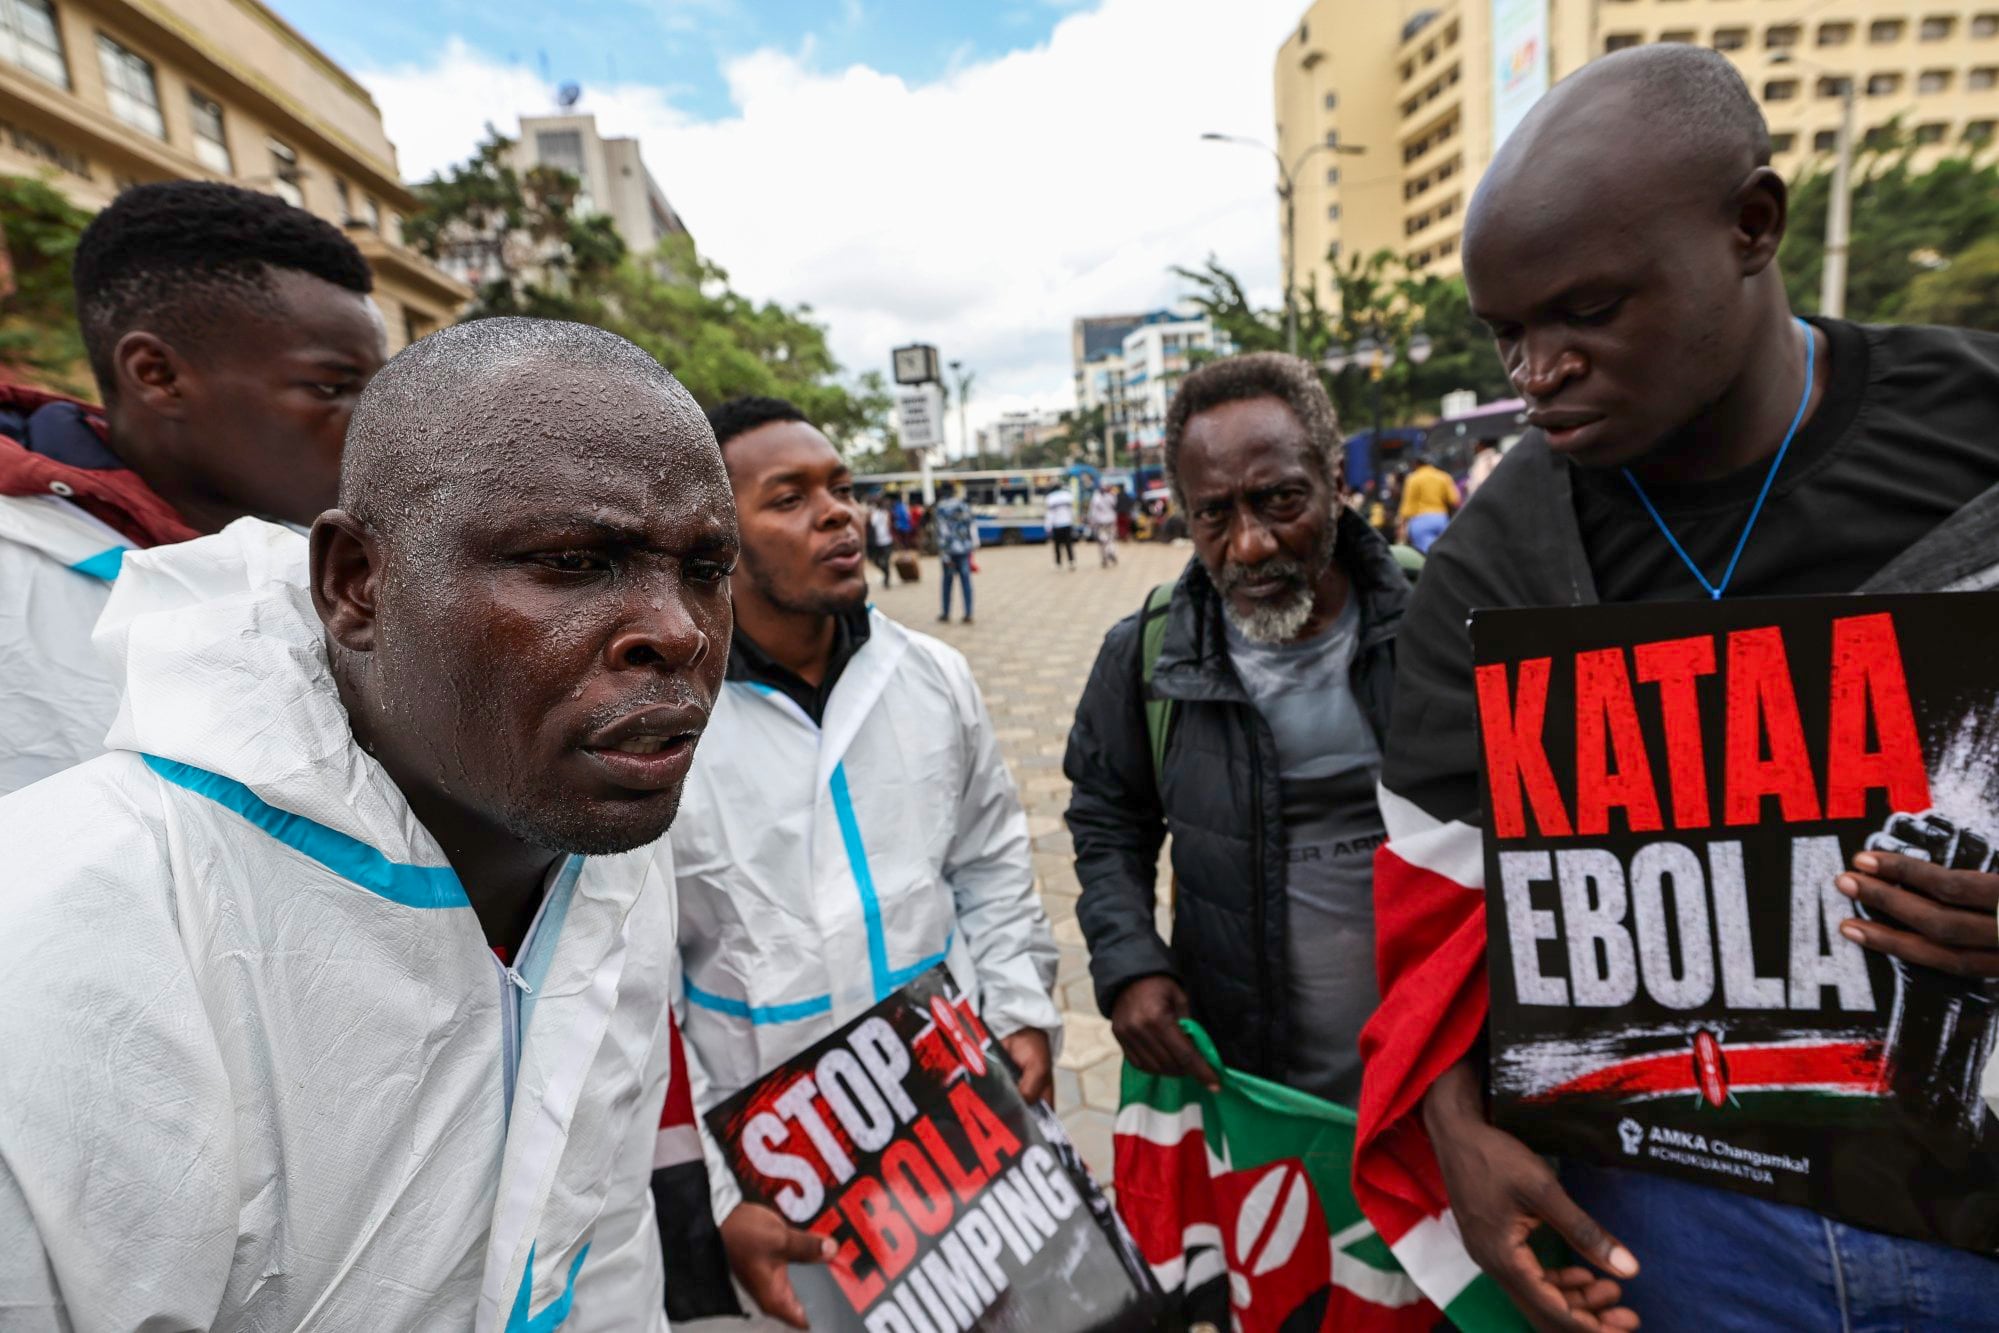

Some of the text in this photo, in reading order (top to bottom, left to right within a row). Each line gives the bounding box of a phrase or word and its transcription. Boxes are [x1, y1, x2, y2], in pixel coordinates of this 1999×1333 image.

[1475, 612, 1934, 838] KATAA
[1498, 835, 1876, 1012] EBOLA
[741, 1016, 918, 1222] STOP
[808, 1080, 1022, 1315] EBOLA
[1648, 1125, 1810, 1174] AMKA Changamka!
